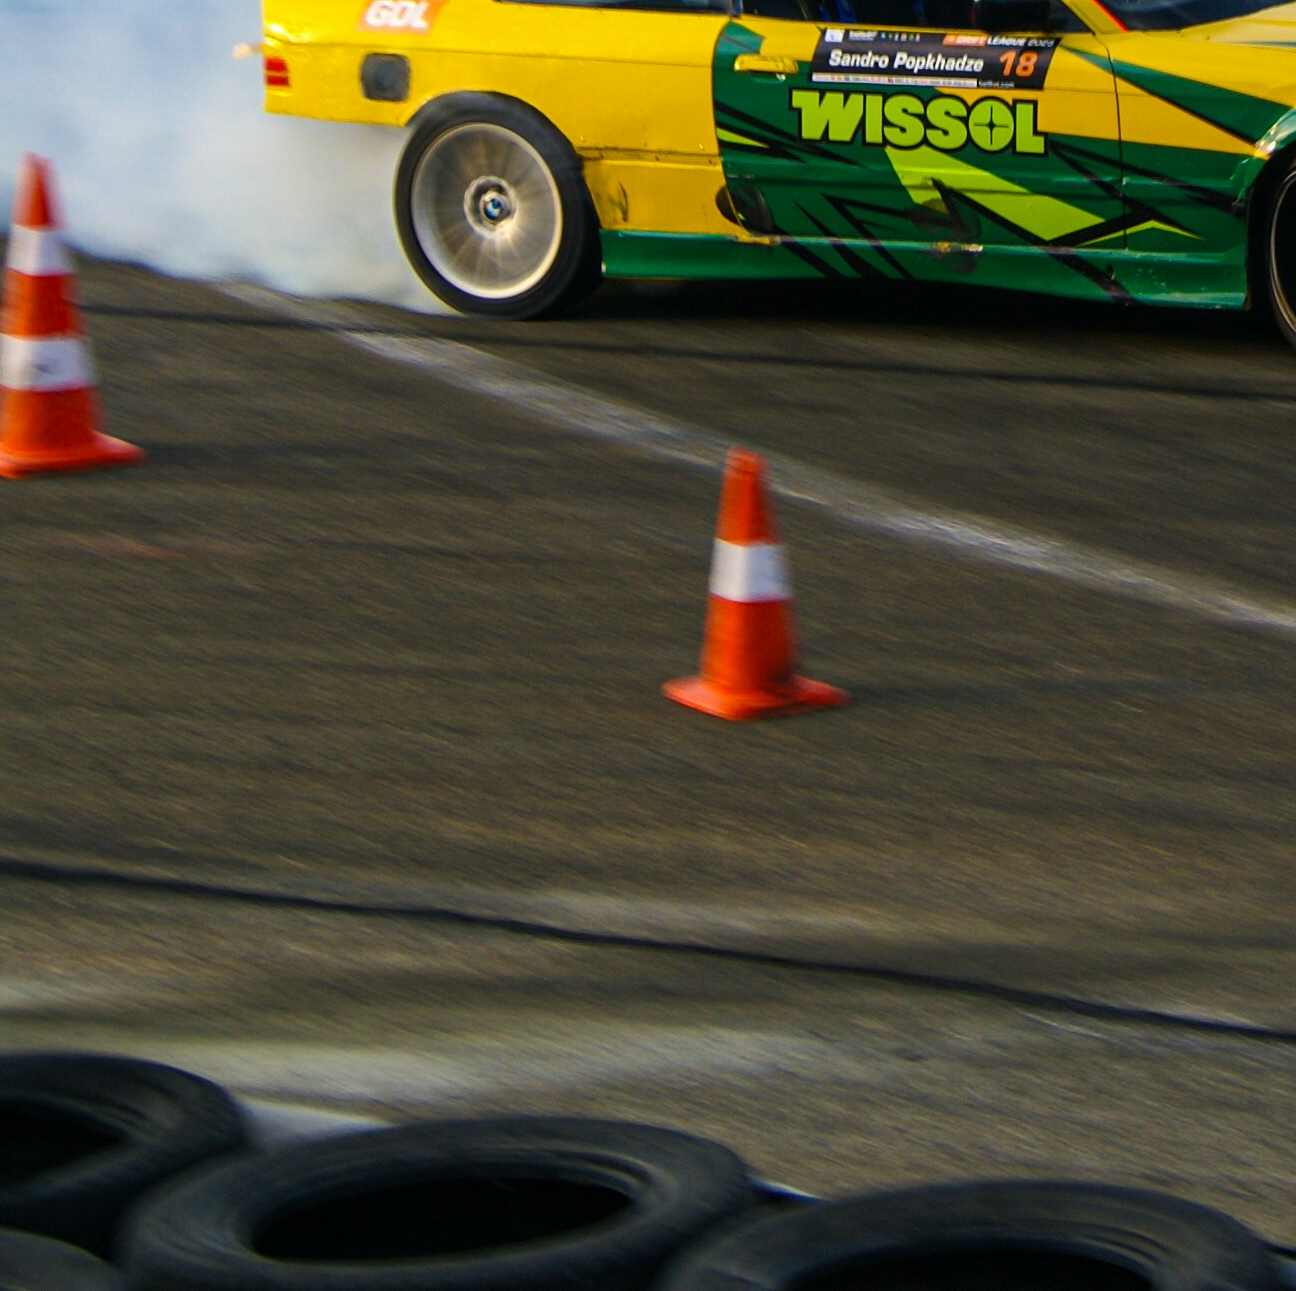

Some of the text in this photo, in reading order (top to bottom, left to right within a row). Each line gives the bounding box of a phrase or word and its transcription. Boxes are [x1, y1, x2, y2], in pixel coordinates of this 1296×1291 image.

[828, 48, 889, 69] Sandro
[999, 49, 1038, 77] 18
[791, 89, 1046, 154] WISSOL
